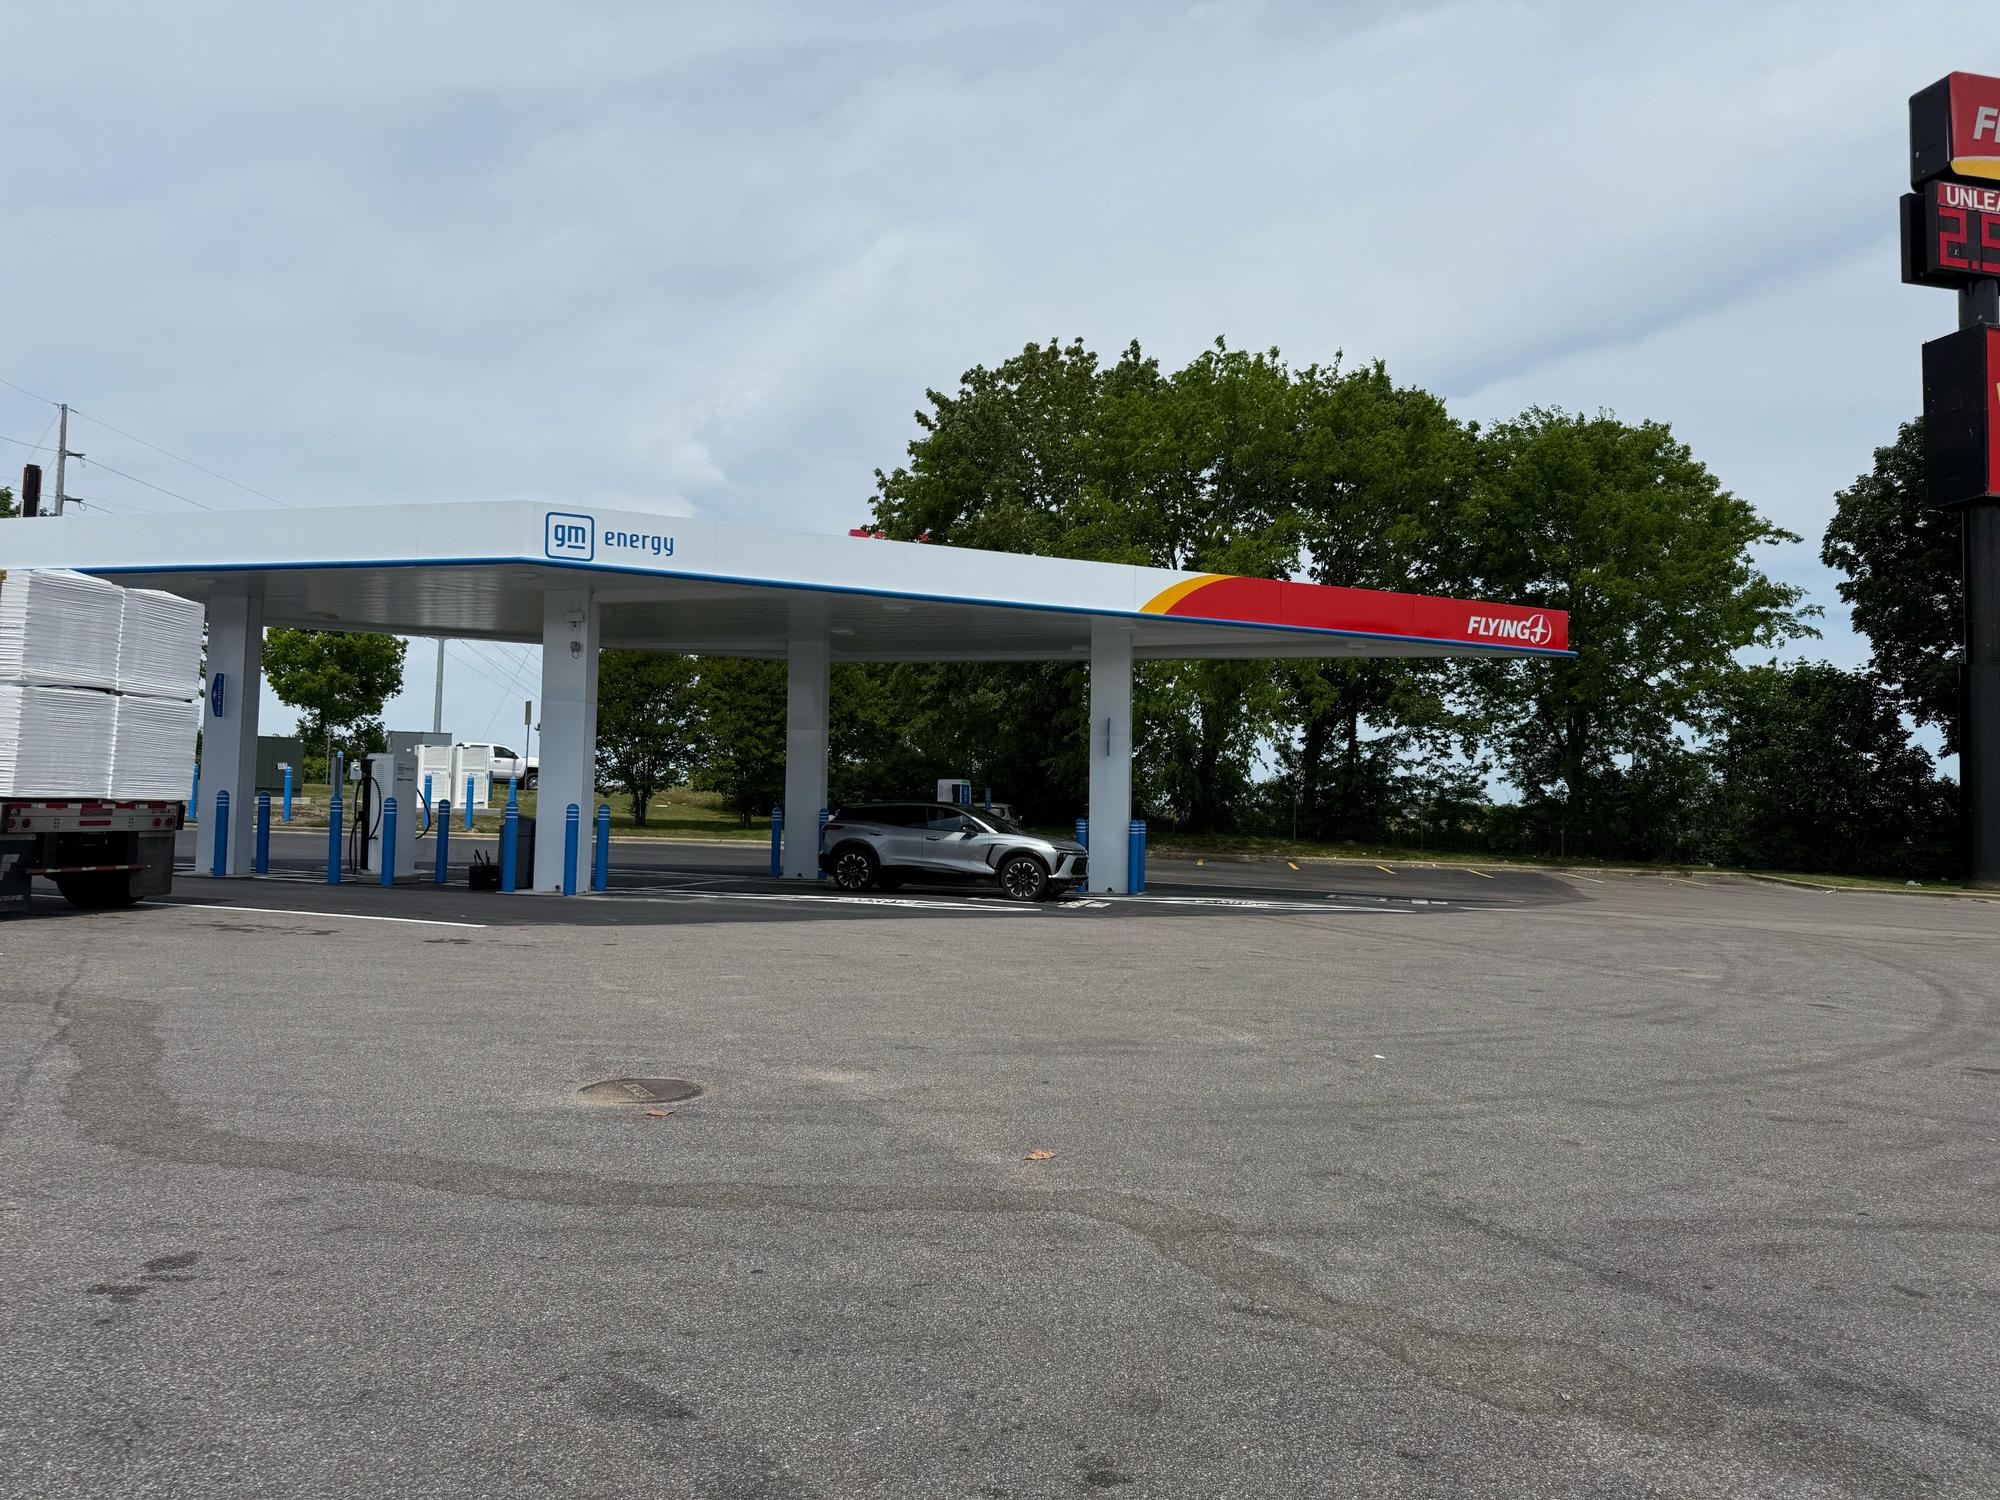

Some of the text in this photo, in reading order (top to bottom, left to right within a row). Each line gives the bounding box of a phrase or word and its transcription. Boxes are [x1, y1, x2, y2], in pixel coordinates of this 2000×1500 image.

[554, 524, 674, 556] gm energy
[1467, 616, 1531, 640] FLYING
